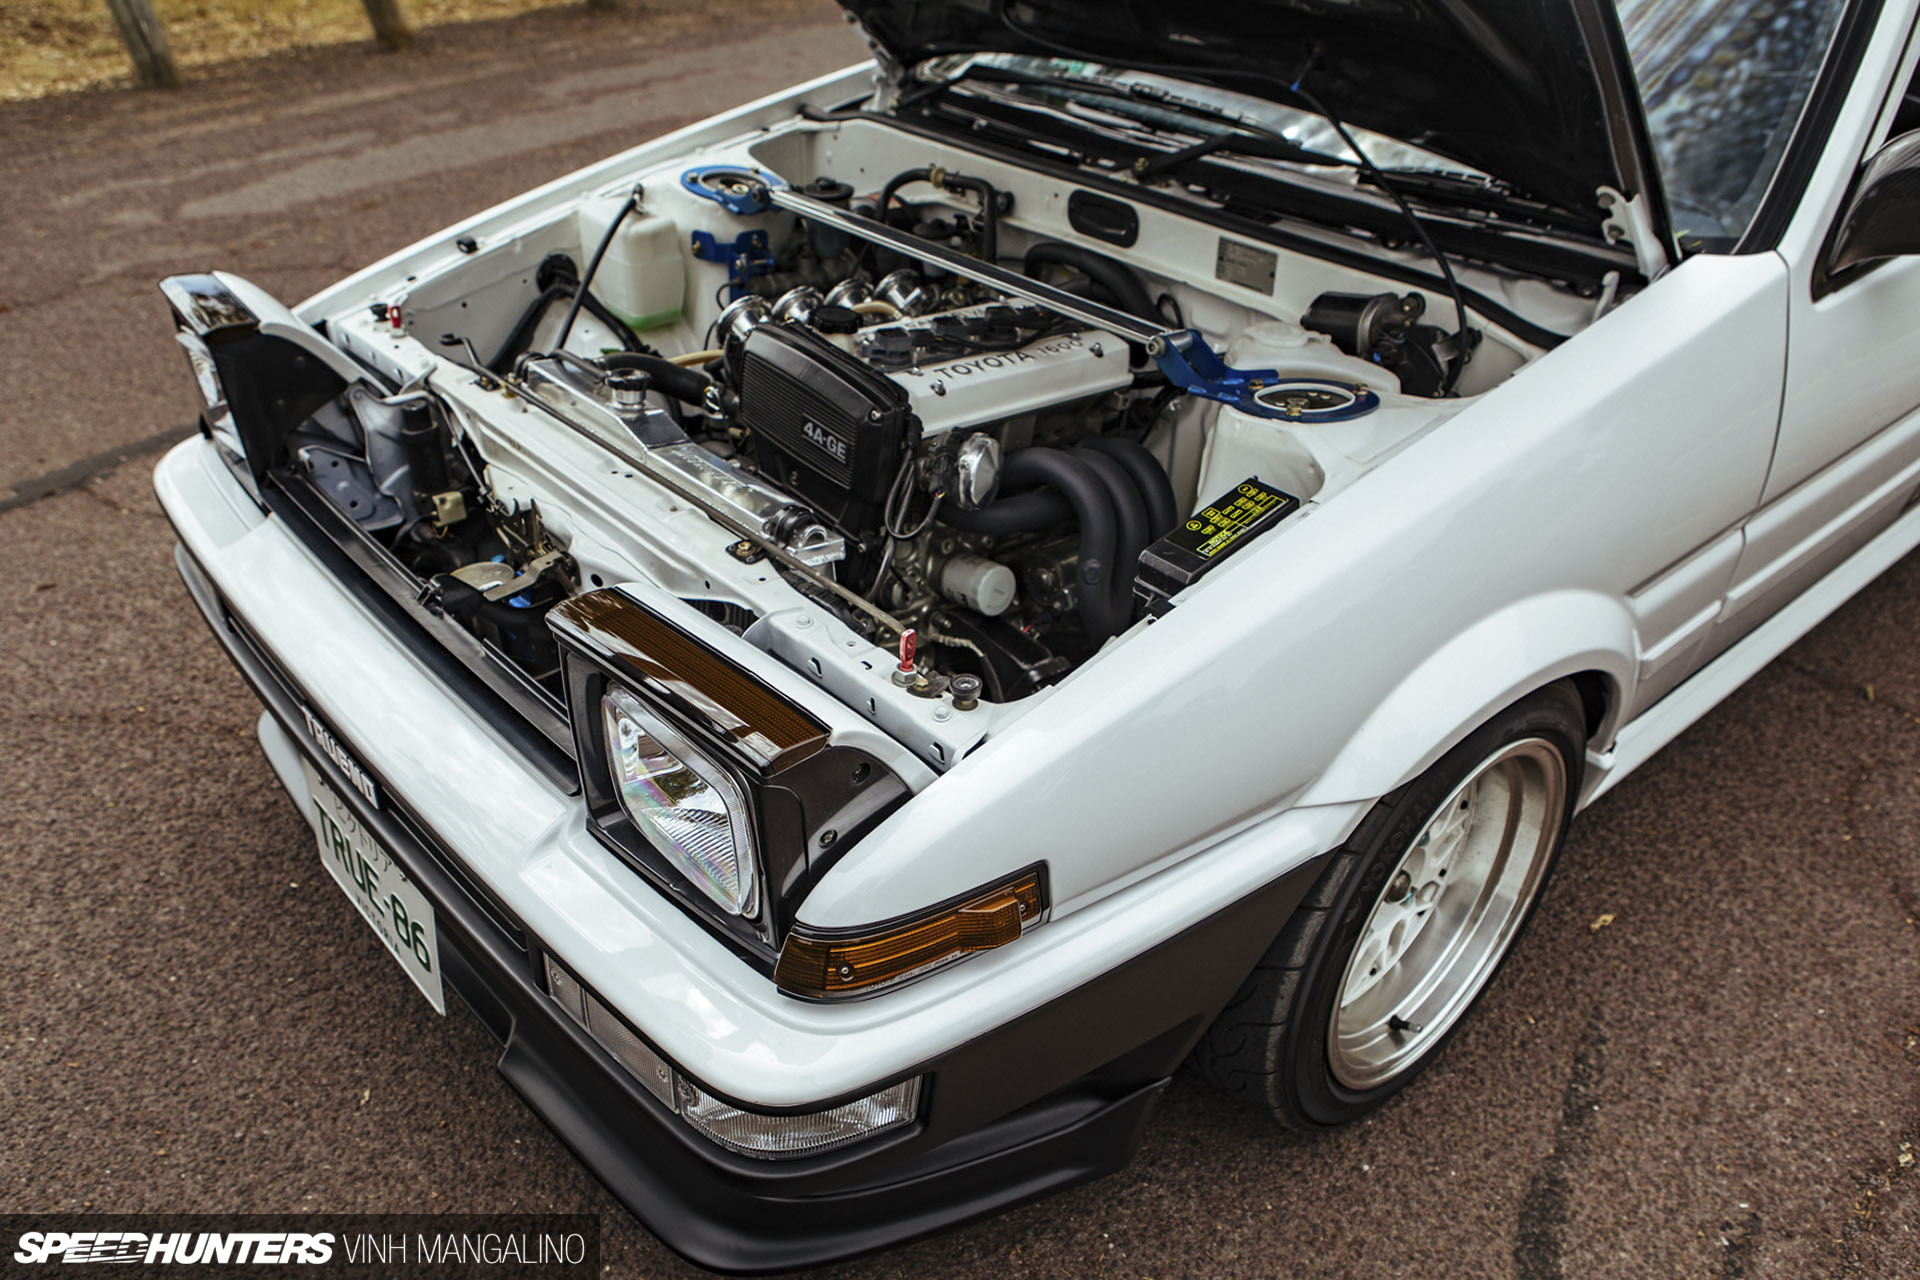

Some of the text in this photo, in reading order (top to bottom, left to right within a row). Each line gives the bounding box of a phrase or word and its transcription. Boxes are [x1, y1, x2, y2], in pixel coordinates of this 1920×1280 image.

[933, 339, 1084, 380] TOYOTA 1600
[300, 705, 379, 810] TRUENO
[312, 794, 432, 974] TRUE-86
